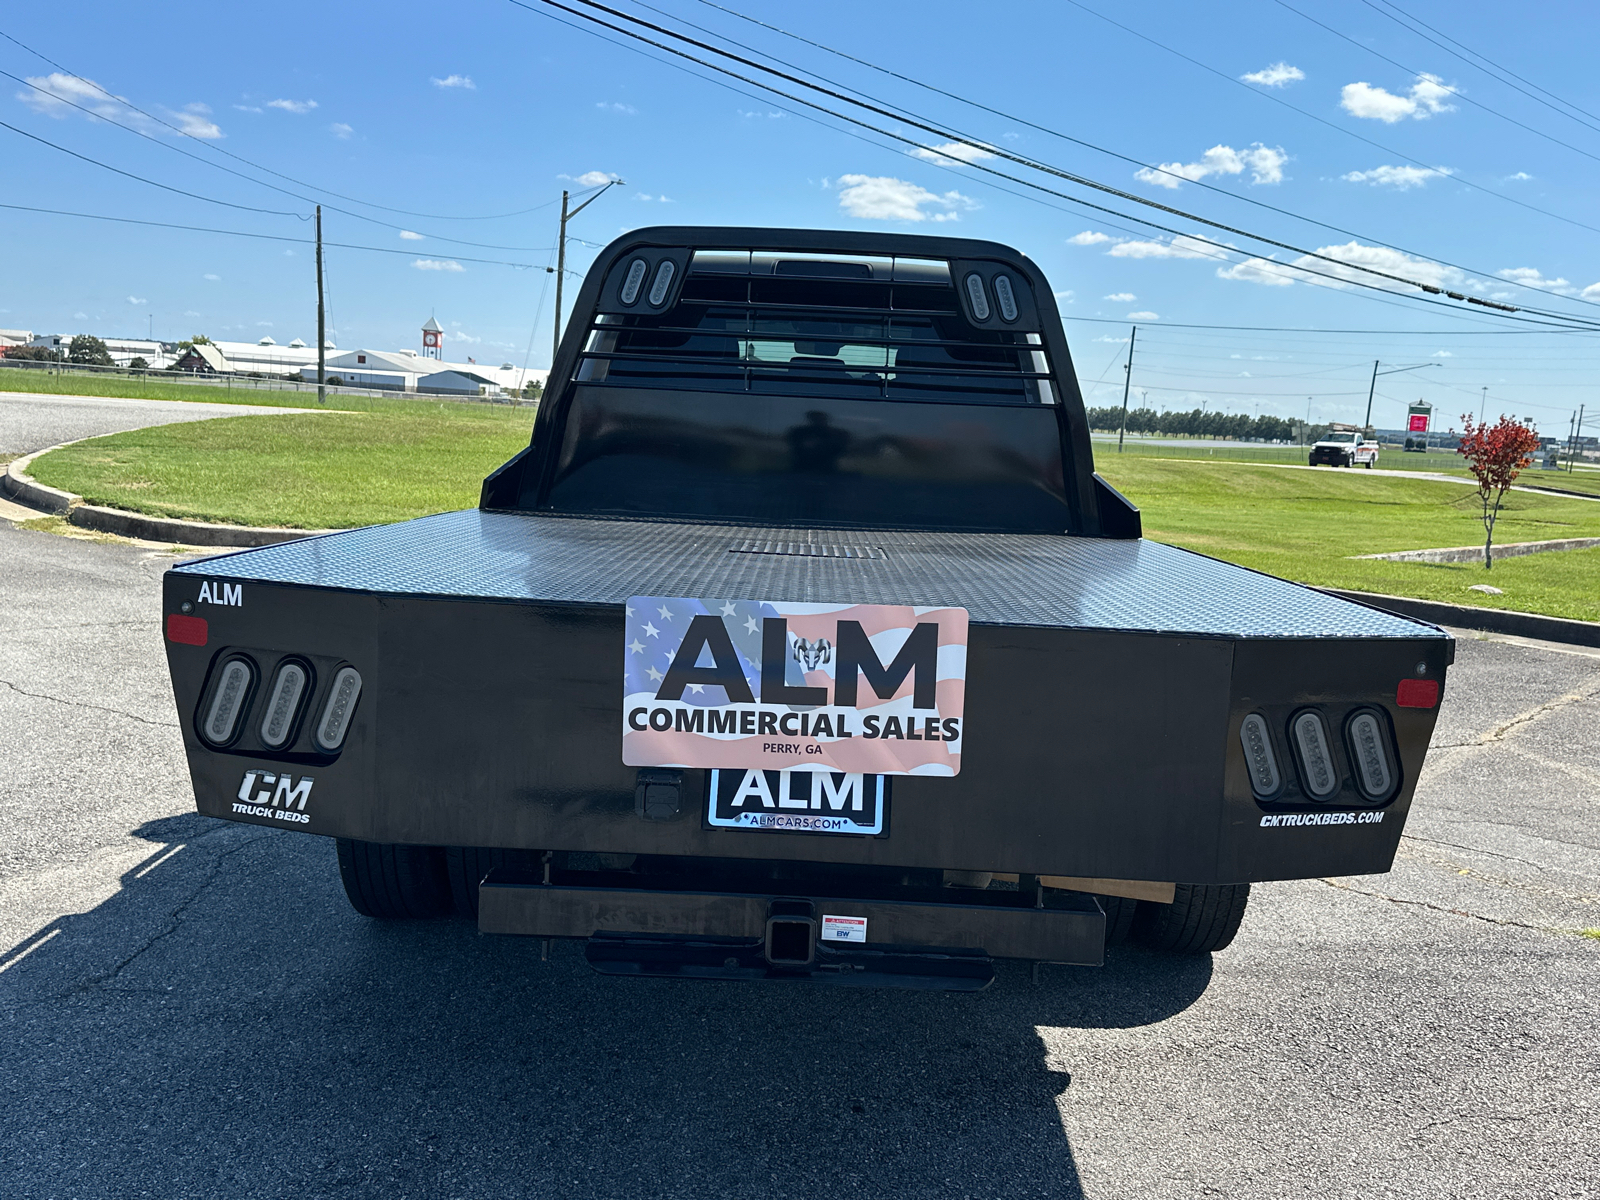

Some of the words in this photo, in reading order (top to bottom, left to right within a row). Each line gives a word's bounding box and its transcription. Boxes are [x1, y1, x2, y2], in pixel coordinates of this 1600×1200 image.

[197, 580, 242, 607] ALM
[654, 614, 939, 710] ALM
[627, 706, 853, 738] COMMERCIAL
[862, 714, 960, 742] SALES
[762, 742, 802, 756] PERRY,
[805, 744, 823, 755] GA
[237, 769, 315, 811] CM
[730, 768, 864, 812] ALM
[231, 802, 274, 819] TRUCK
[274, 810, 311, 824] BEDS
[749, 815, 842, 830] ALMCARS.COM
[1259, 812, 1385, 827] CMTRUCKBEDS.COM
